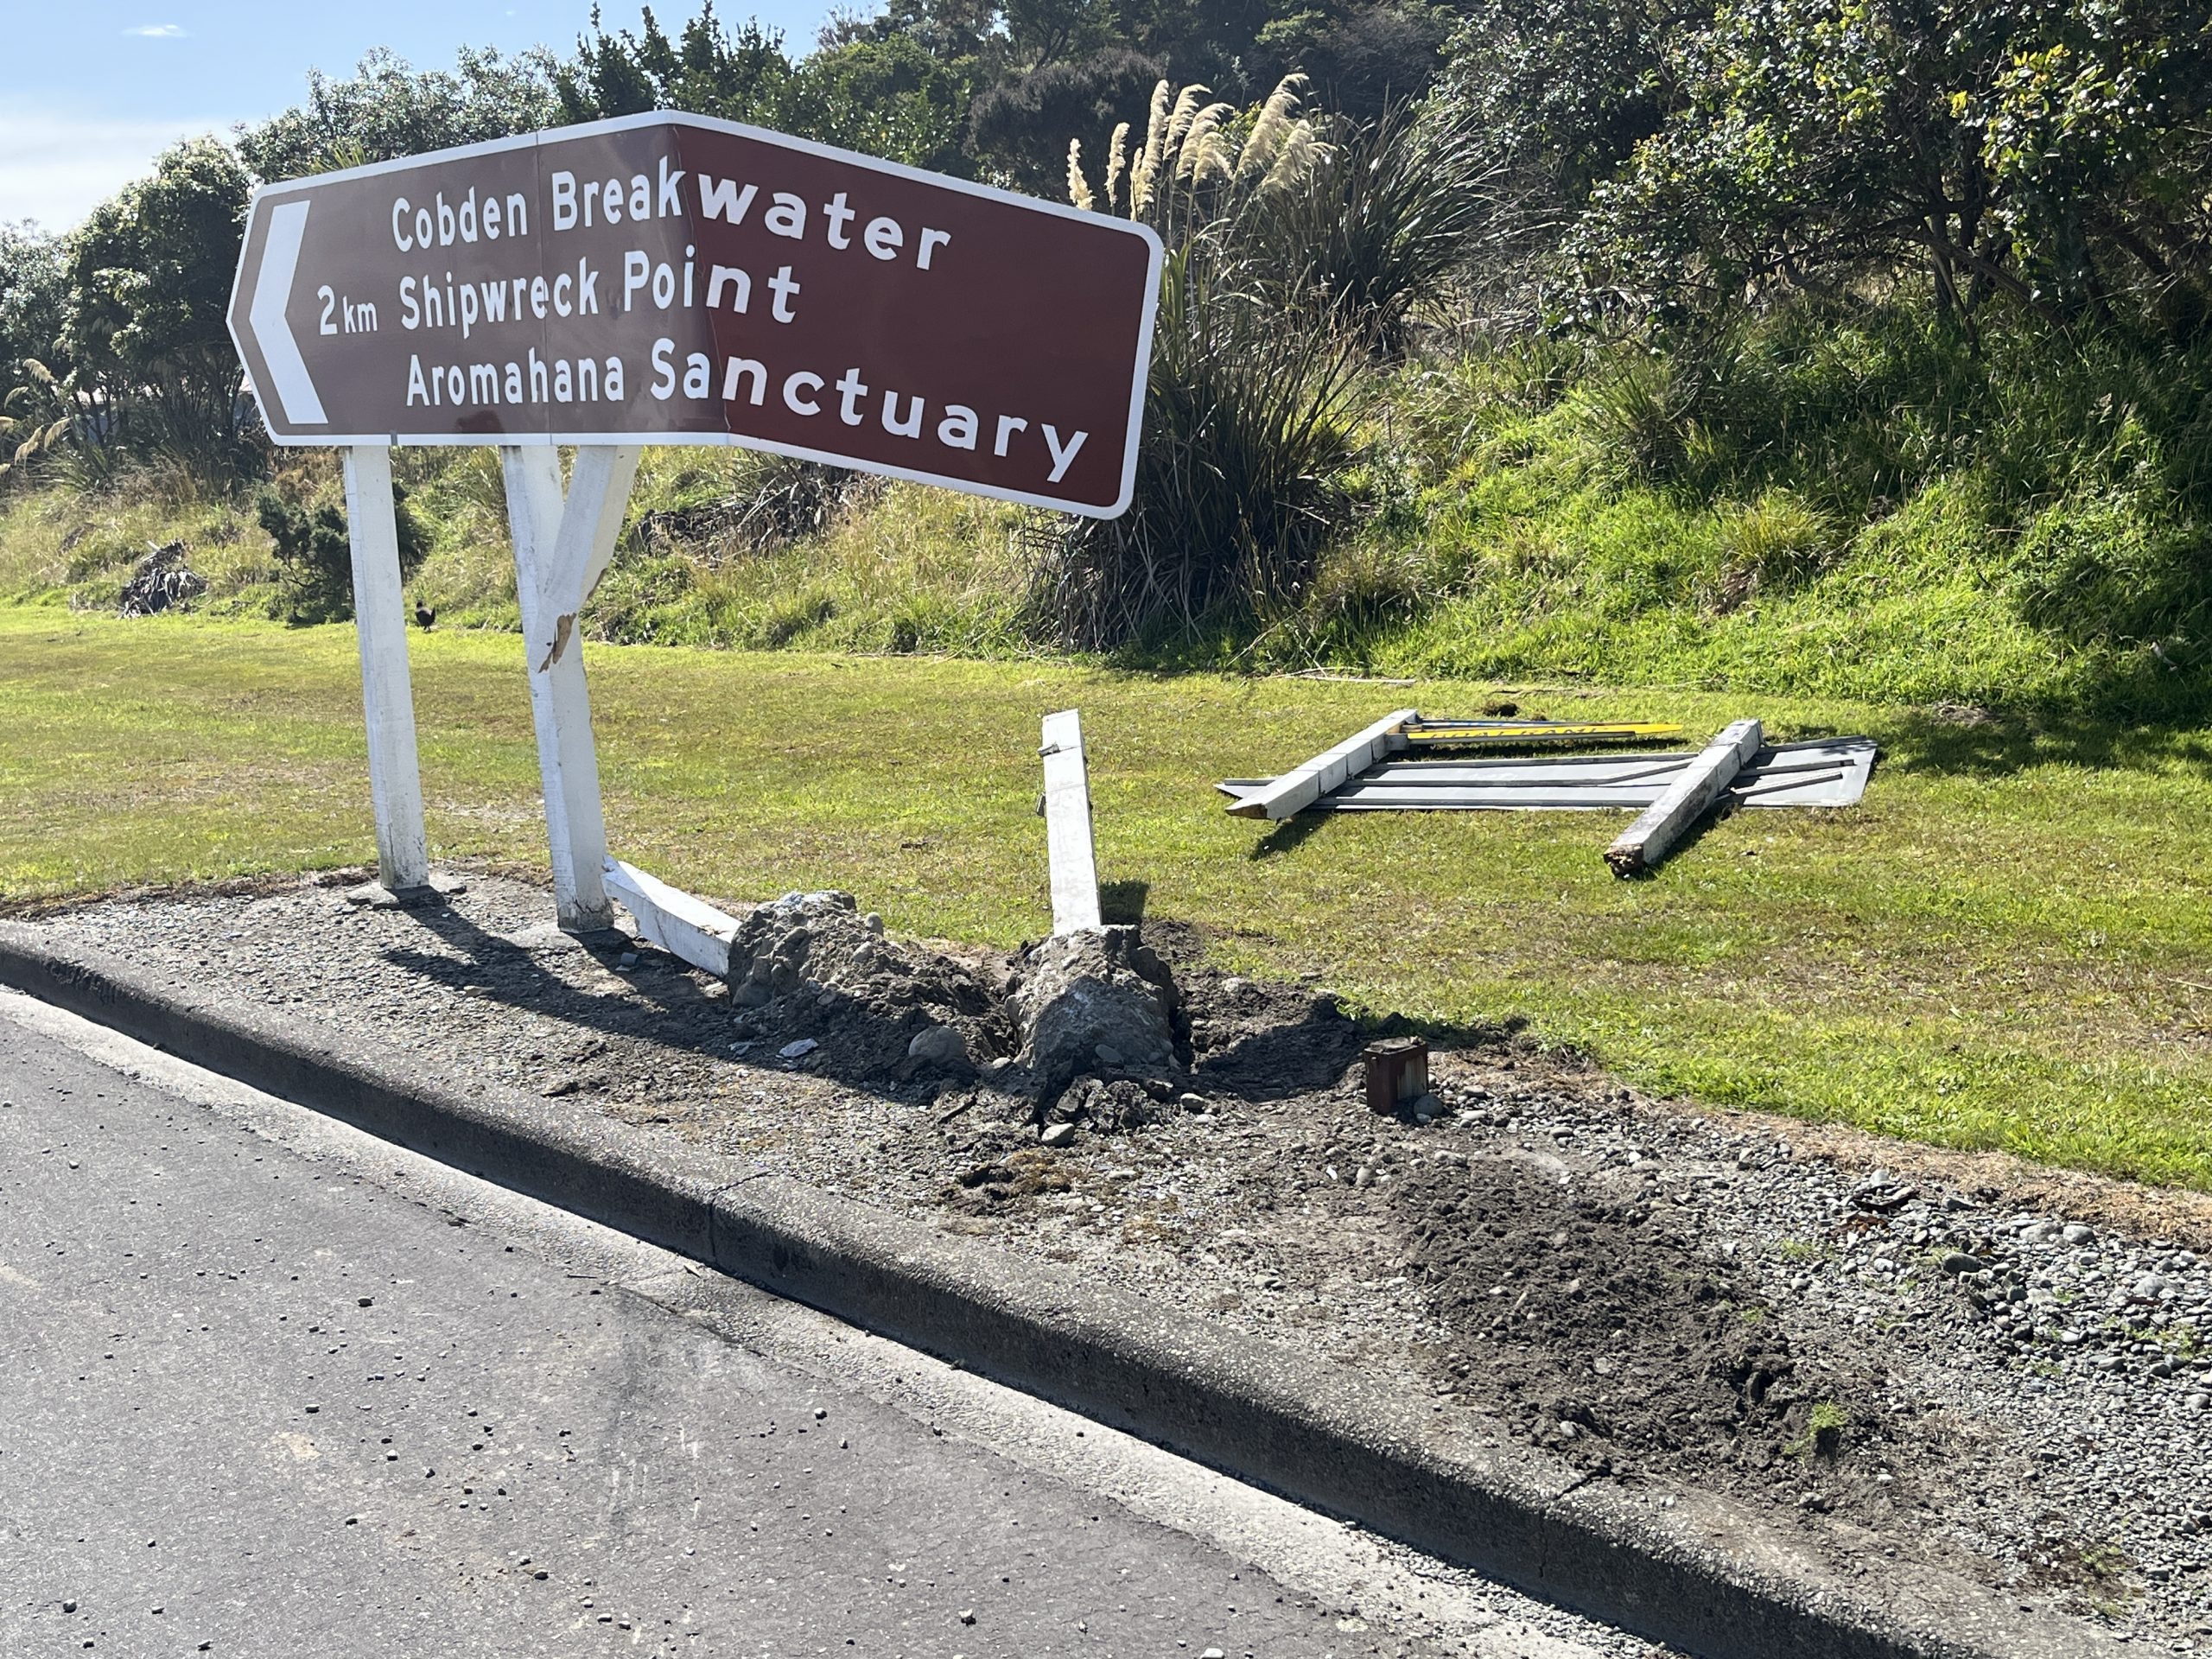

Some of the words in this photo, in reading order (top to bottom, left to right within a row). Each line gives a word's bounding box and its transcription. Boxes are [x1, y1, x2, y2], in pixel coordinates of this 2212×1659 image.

[391, 186, 529, 253] Cobden
[550, 156, 952, 271] Breakwater
[398, 256, 600, 340] Shipwreck
[623, 245, 801, 324] Point
[405, 346, 626, 407] Aromahana
[650, 336, 1090, 483] Sanctuary
